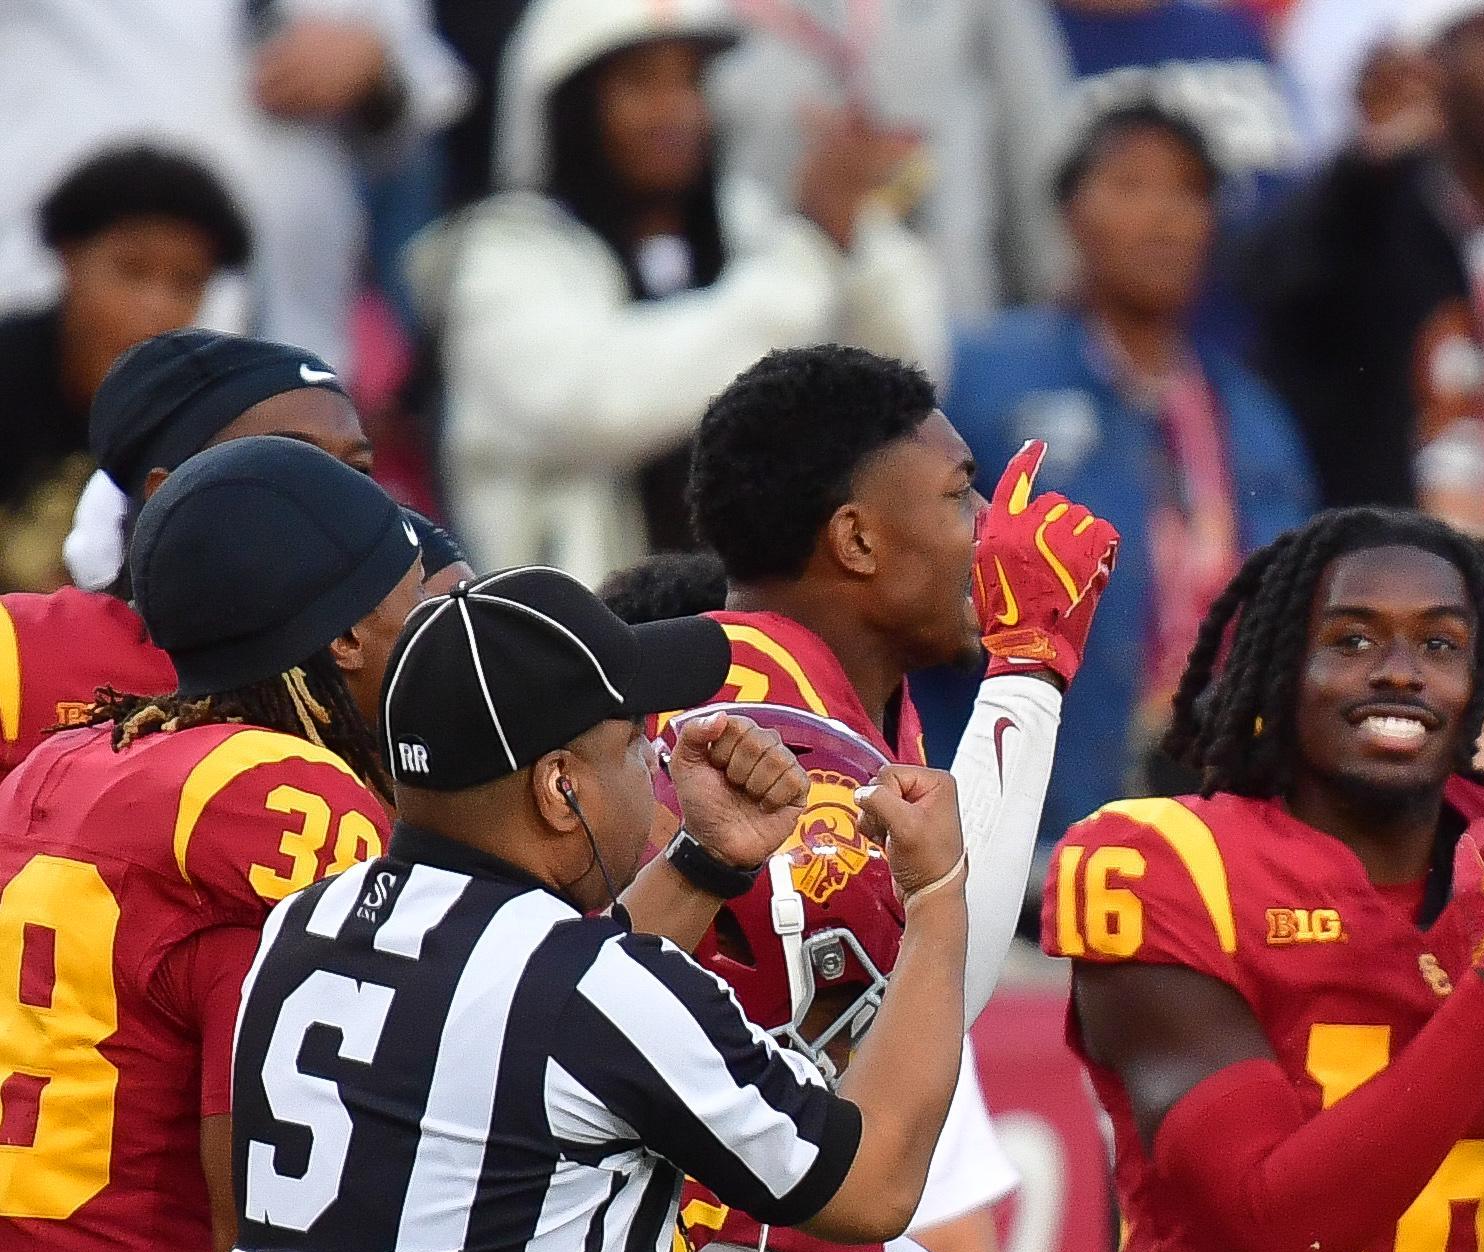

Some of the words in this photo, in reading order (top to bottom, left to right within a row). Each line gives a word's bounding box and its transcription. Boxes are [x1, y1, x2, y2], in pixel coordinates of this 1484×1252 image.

[398, 742, 430, 774] RR
[1056, 845, 1147, 957] 16
[245, 969, 396, 1233] S
